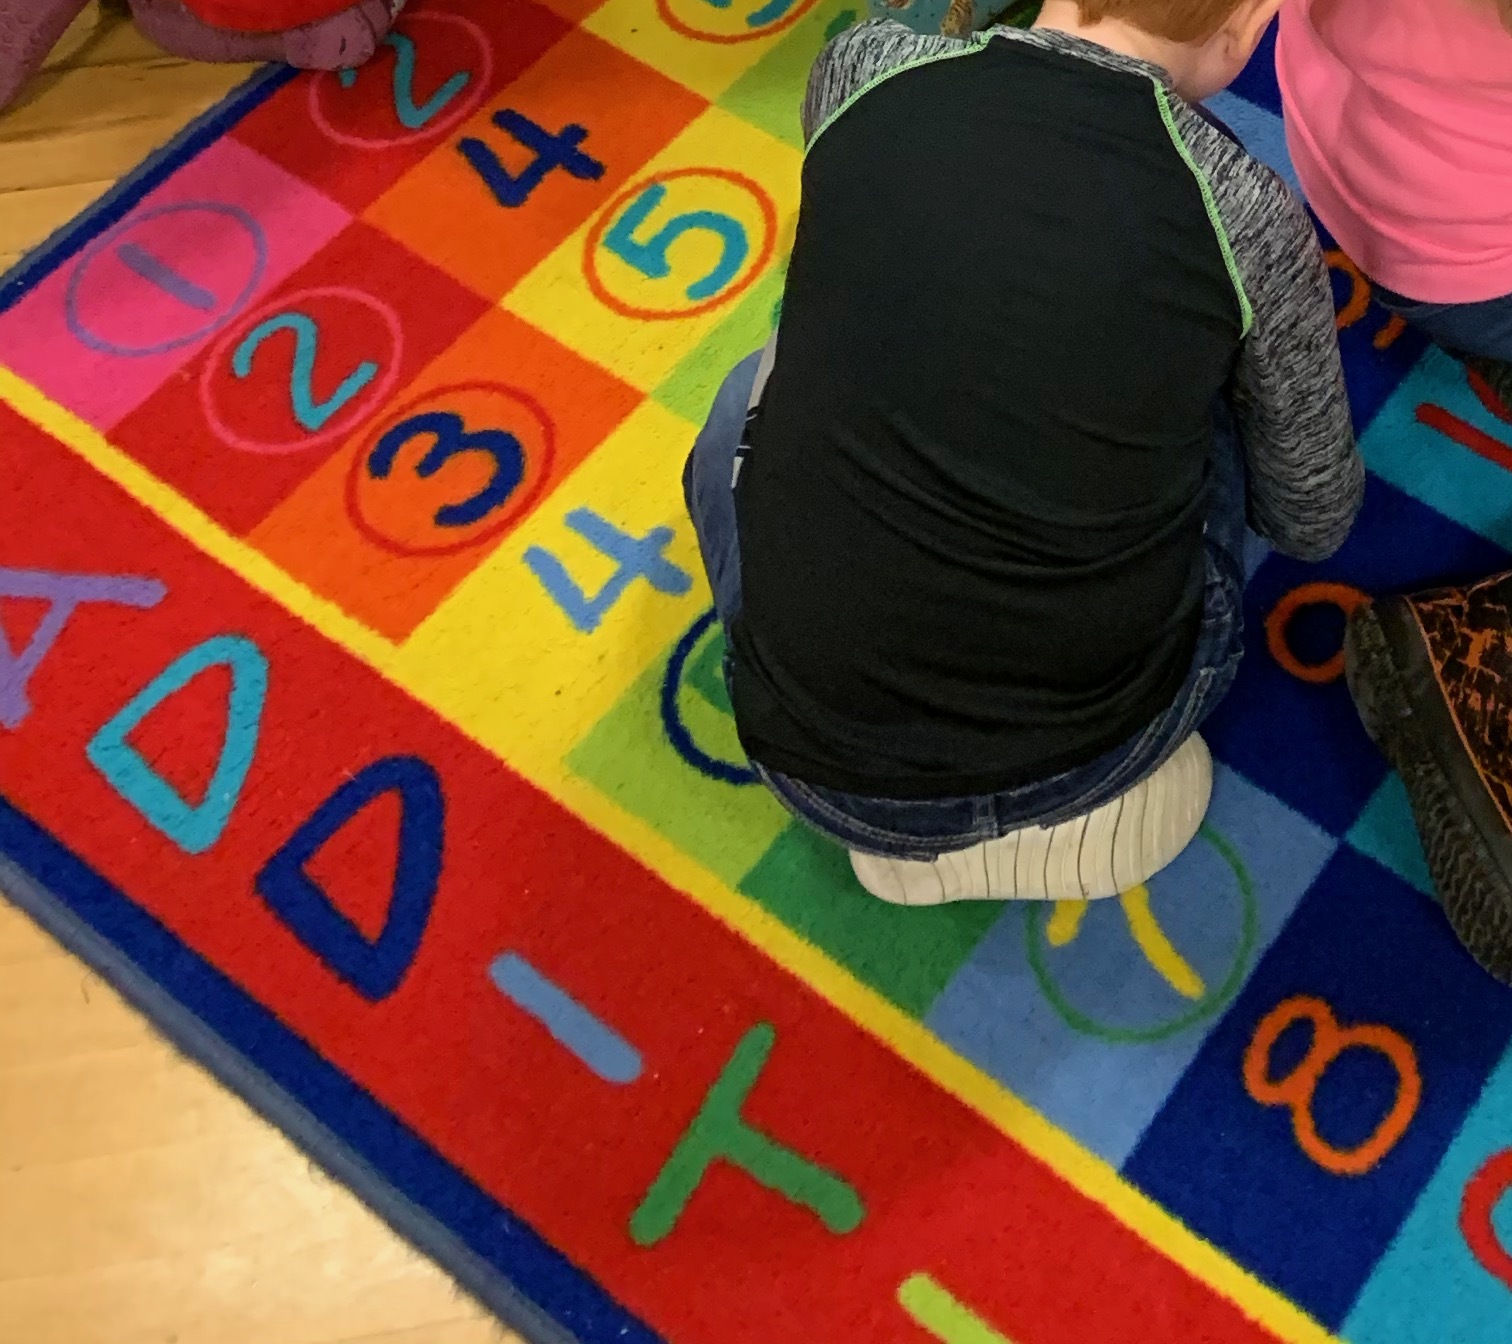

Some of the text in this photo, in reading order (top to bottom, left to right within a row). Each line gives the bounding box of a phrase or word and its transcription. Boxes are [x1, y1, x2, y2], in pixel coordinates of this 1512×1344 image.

[457, 109, 606, 208] 4
[605, 183, 749, 300] 5
[232, 312, 378, 431] 2
[368, 412, 526, 526] 3
[522, 508, 693, 632] 4
[1243, 994, 1422, 1174] 8
